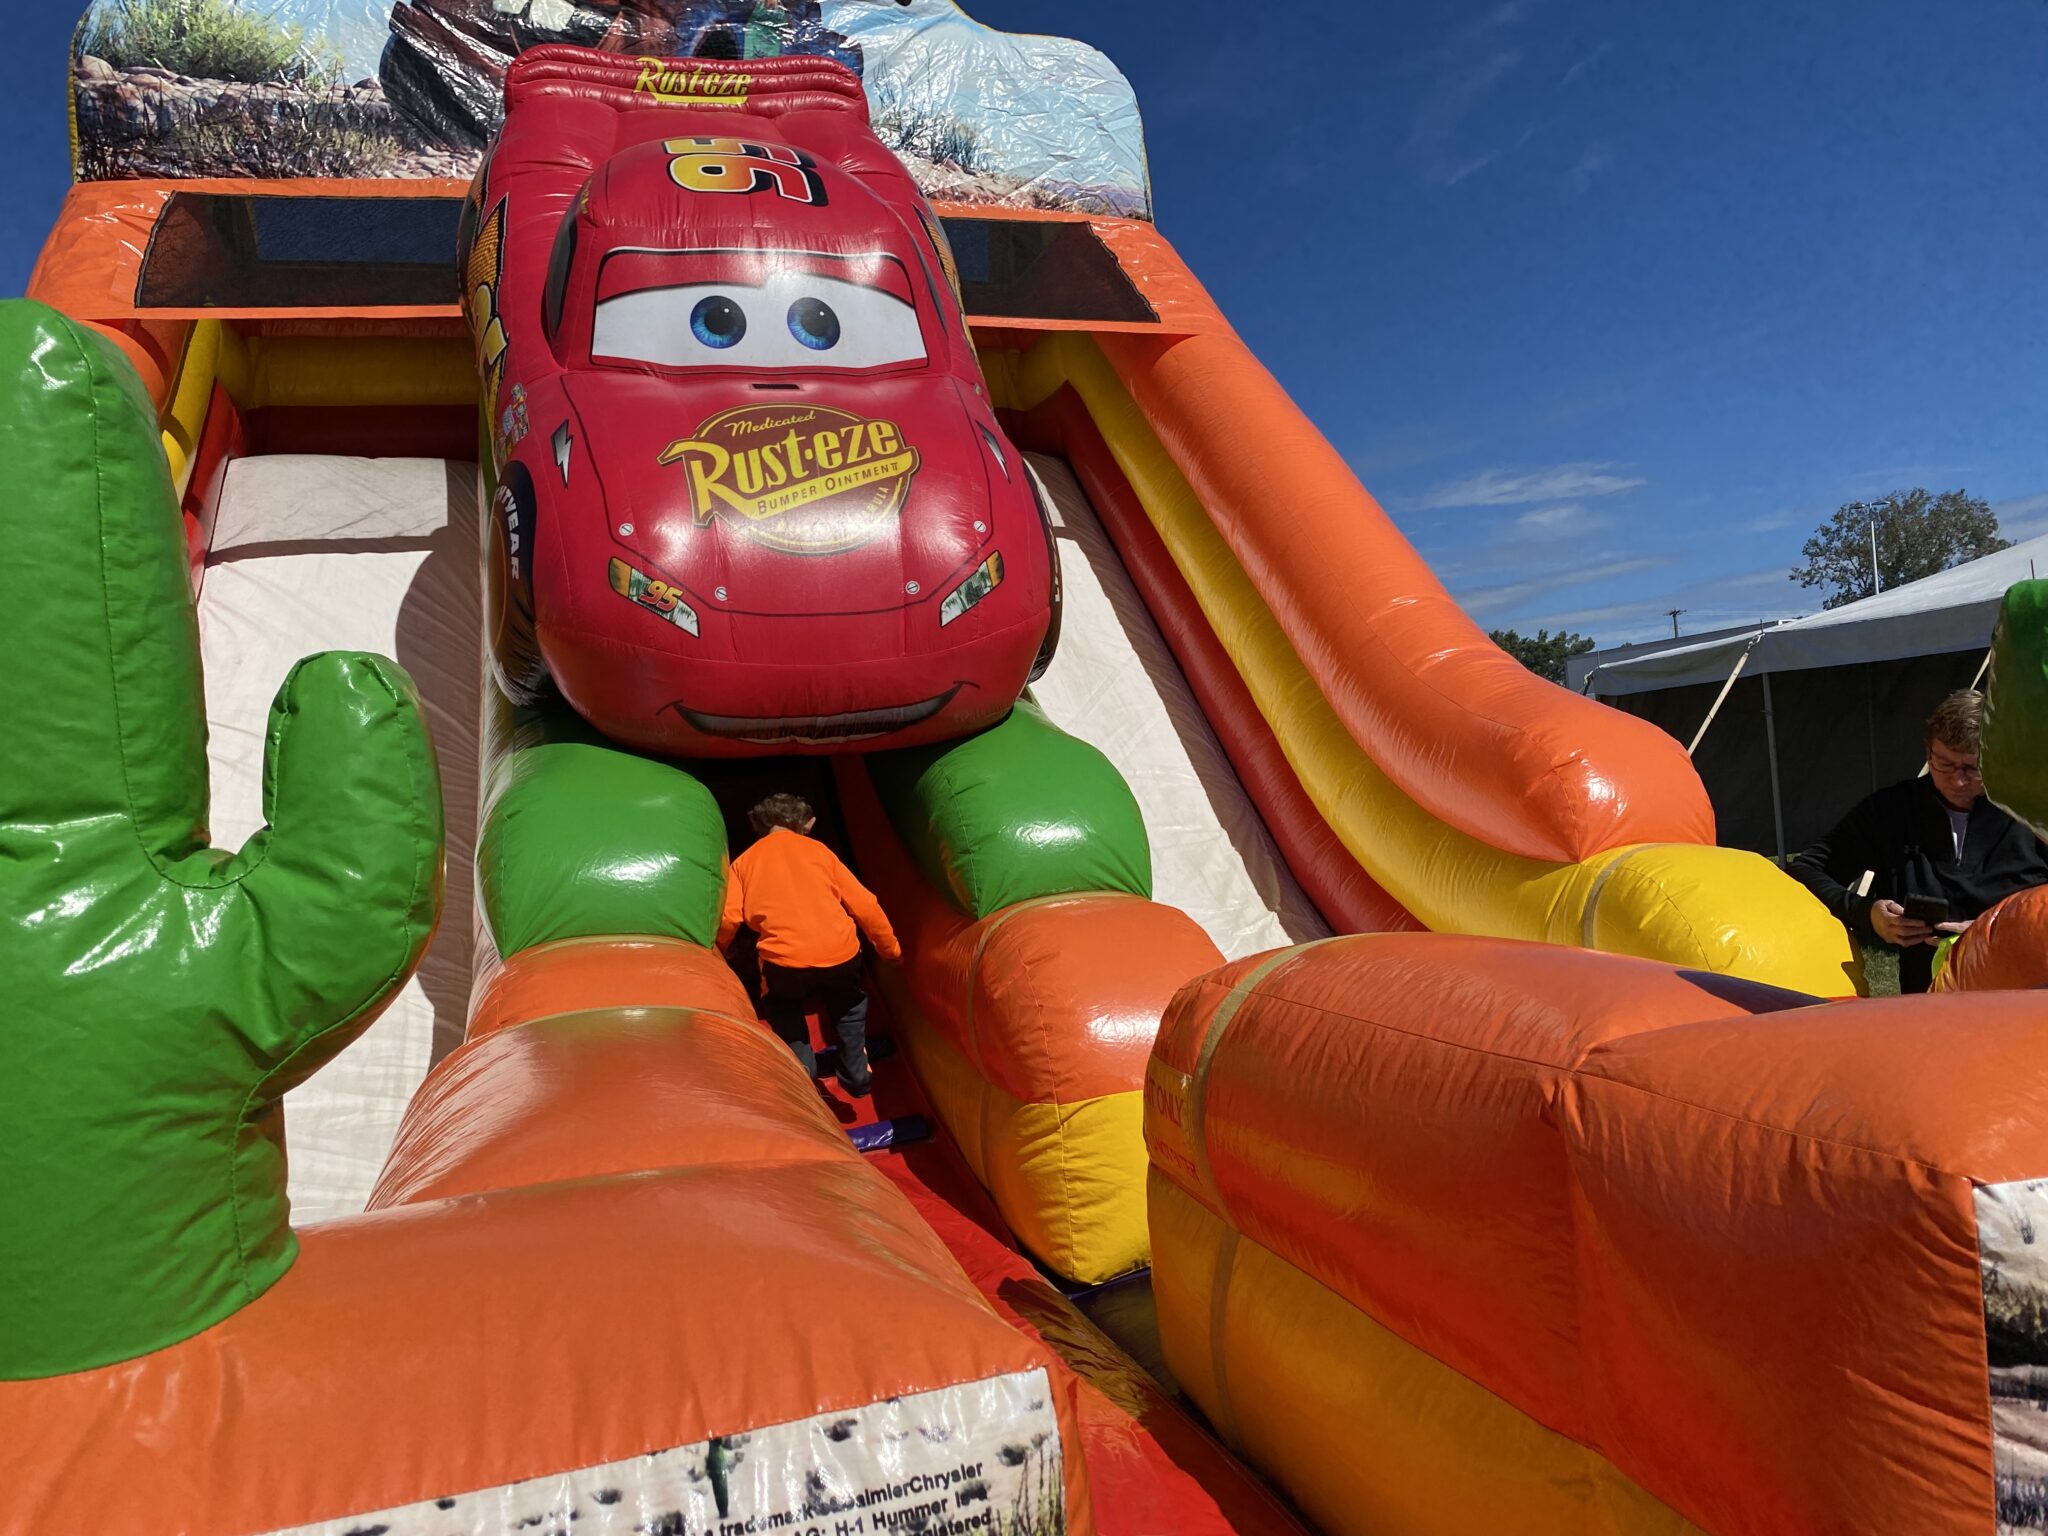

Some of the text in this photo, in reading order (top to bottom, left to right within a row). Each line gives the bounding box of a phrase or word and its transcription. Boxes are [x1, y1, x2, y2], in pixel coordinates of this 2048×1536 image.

[724, 410, 816, 437] Medicated
[757, 486, 817, 515] BUMPER
[639, 580, 684, 613] 95
[1157, 1085, 1184, 1128] ONLY
[872, 1498, 948, 1531] Hummer
[909, 1507, 991, 1536] gistered
